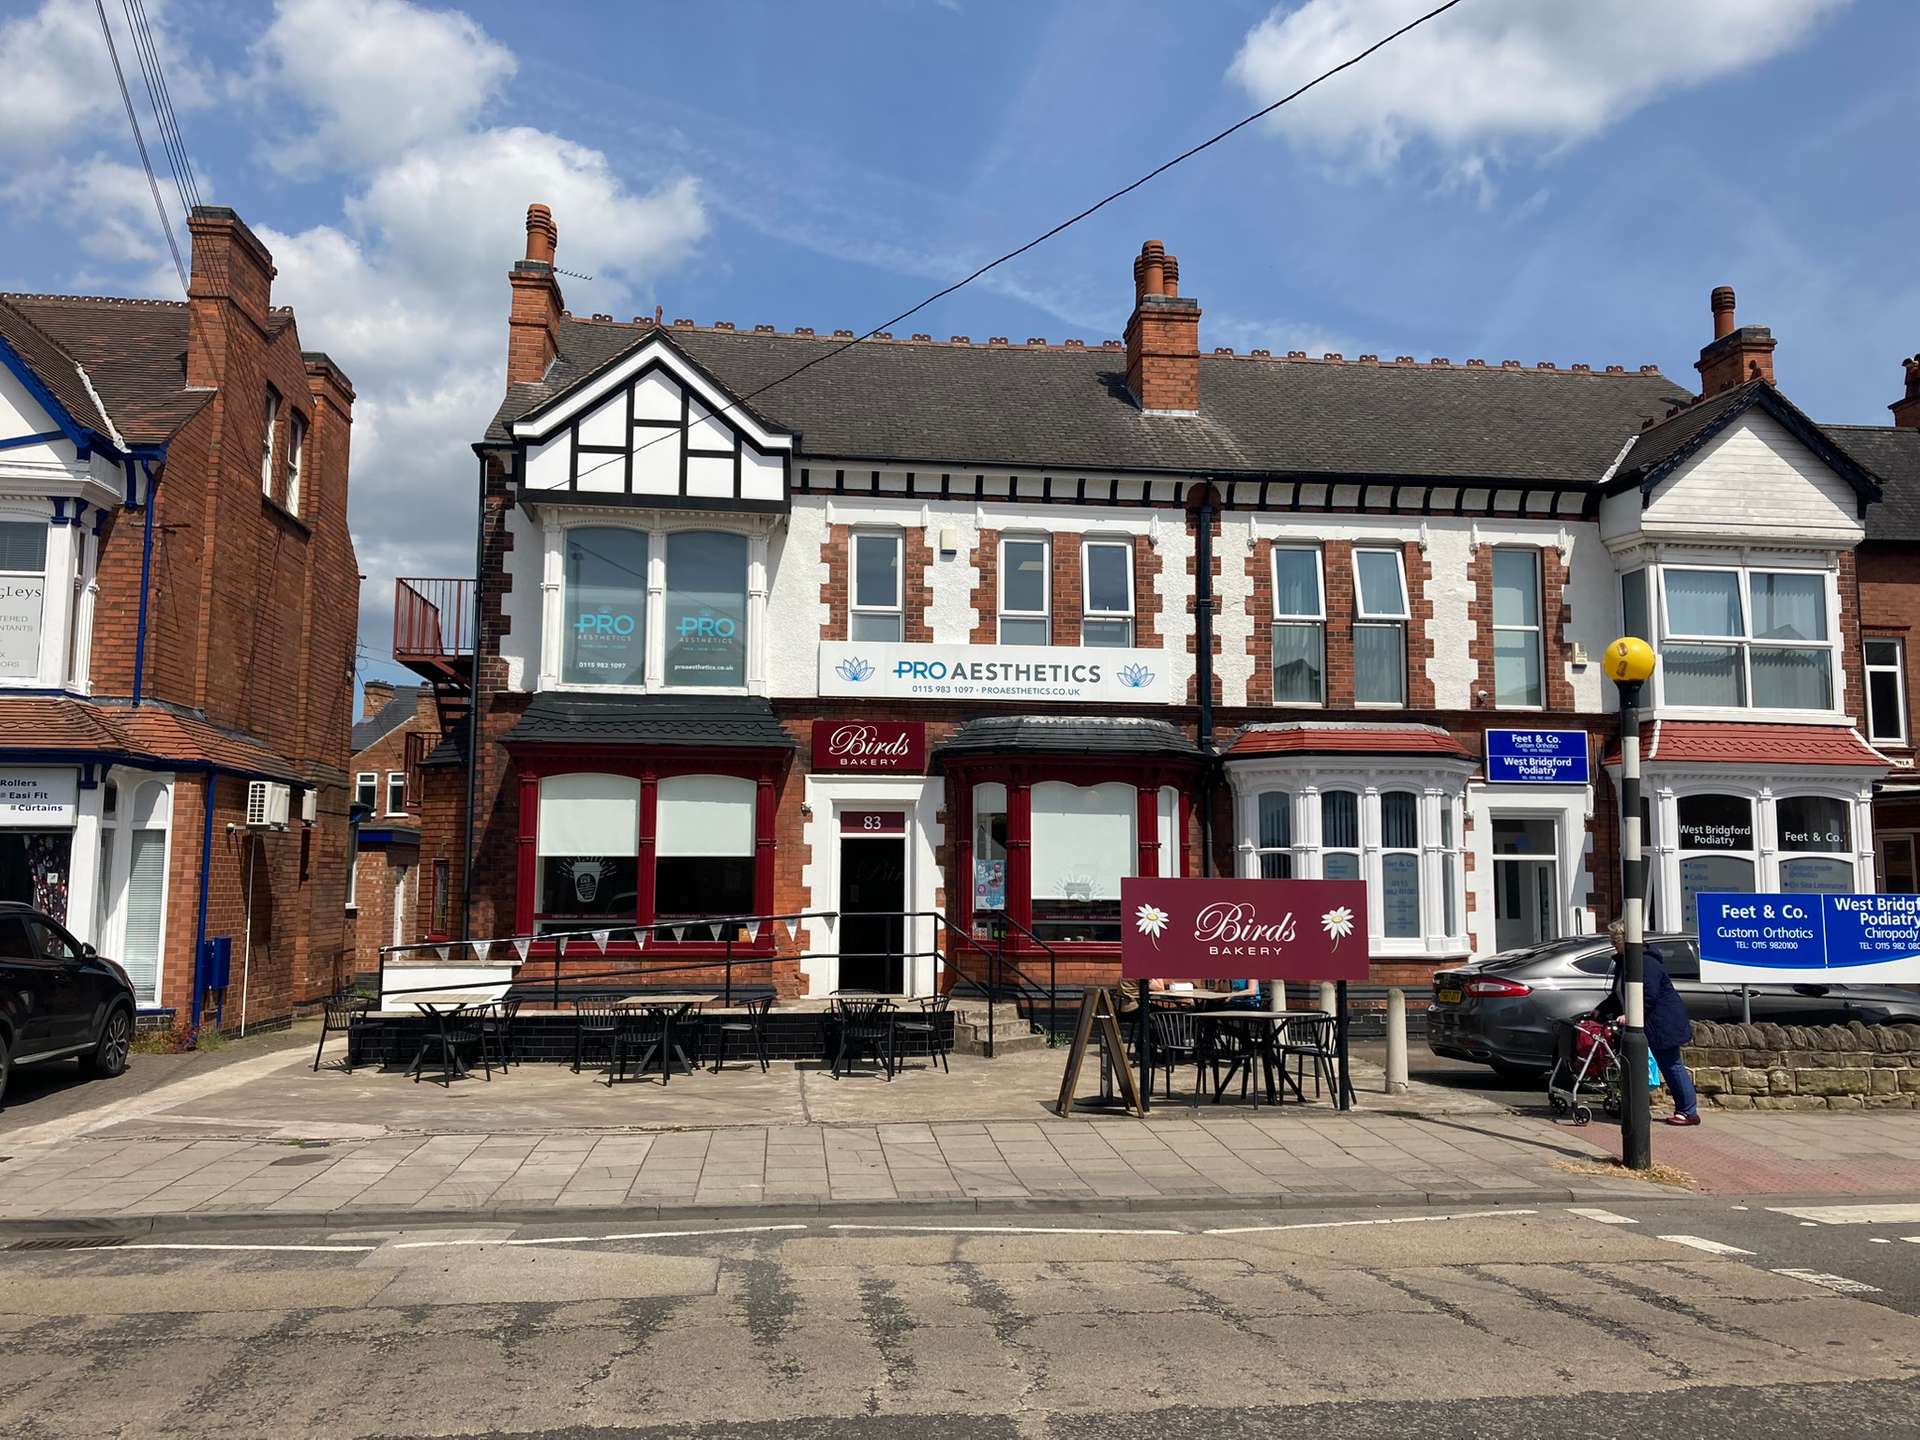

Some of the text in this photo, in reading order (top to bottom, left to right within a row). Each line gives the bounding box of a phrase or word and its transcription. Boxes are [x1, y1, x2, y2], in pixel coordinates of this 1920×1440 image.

[575, 614, 635, 636] PRO
[675, 616, 736, 638] PRO
[577, 634, 632, 642] AESTHETICS
[679, 637, 733, 645] AESTHETICS
[578, 661, 595, 669] 0115
[610, 662, 626, 670] 1097
[674, 664, 734, 672] proaesthetics.co.uk
[893, 661, 1101, 683] PRO AESTHETICS
[912, 685, 933, 693] 0115
[954, 686, 974, 694] 1097
[981, 687, 1081, 696] PROAESTHETICS.CO.UK
[829, 725, 910, 756] Birds
[1512, 734, 1562, 744] Feet & Co.
[1504, 757, 1572, 768] West Bridgford
[1519, 766, 1557, 777] Podiatry
[18, 804, 63, 812] Curtains
[864, 816, 882, 830] 83
[1679, 825, 1751, 837] West Bridgford
[1785, 831, 1843, 843] Feet & Co.
[1694, 835, 1735, 847] Podiatry
[1834, 898, 1874, 911] West
[1722, 904, 1808, 919] Feet & Co.
[1195, 902, 1297, 942] Birds
[1861, 911, 1920, 929] Podiatry
[1717, 926, 1814, 939] Custom Orthotics
[1865, 927, 1919, 941] Chiropody
[1735, 941, 1799, 949] TEL: 0115 9820100
[1859, 942, 1873, 950] TEL:
[1875, 942, 1891, 950] 0115
[1892, 942, 1906, 950] 982
[1209, 947, 1282, 956] BAKERY
